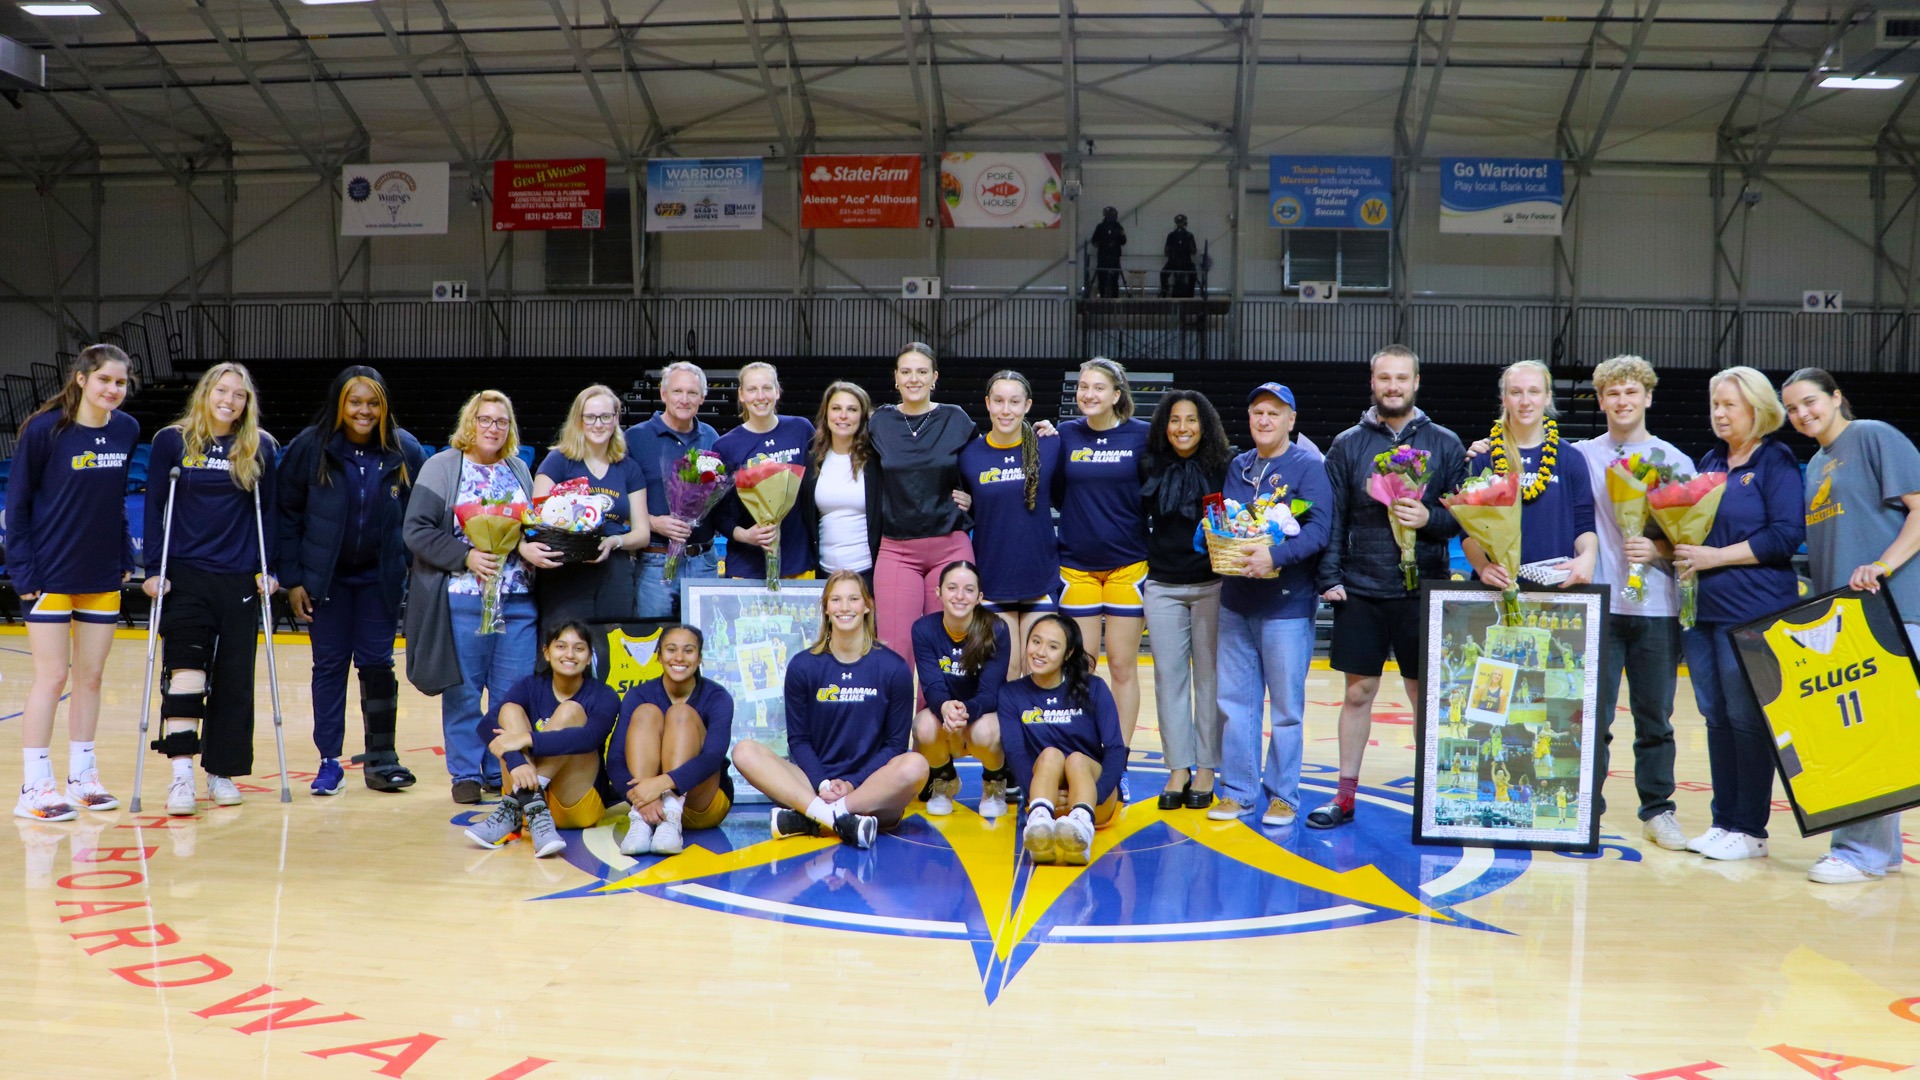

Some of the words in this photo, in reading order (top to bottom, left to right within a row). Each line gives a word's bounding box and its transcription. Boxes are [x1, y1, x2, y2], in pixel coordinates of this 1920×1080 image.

[536, 171, 546, 182] H
[546, 164, 586, 180] WILSON
[666, 168, 743, 179] WARRIORS
[1292, 165, 1319, 174] Thank
[1337, 166, 1348, 174] for
[1349, 166, 1371, 176] being
[1454, 162, 1474, 177] Go
[1479, 163, 1547, 178] Warriors!
[1280, 176, 1318, 184] Warriors
[1320, 177, 1337, 185] with
[1455, 181, 1473, 192] Play
[1501, 181, 1523, 191] Bank
[1525, 183, 1548, 192] local.
[1312, 187, 1359, 198] Supporting
[804, 195, 838, 204] Aleene
[841, 194, 870, 204] "Ace"
[872, 195, 917, 204] Althouse
[983, 199, 1017, 207] HOUSE
[1316, 197, 1347, 206] Student
[525, 212, 541, 221] (831)
[542, 212, 572, 220] 423-9522
[1315, 208, 1347, 216] Success.
[1516, 212, 1529, 223] Bay
[1530, 212, 1556, 220] Federal
[452, 285, 463, 298] H
[928, 281, 932, 294] I
[1323, 285, 1332, 299] J
[1824, 295, 1837, 308] K
[588, 487, 620, 498] ALIFORNIA
[1800, 657, 1878, 699] SLUGS
[840, 687, 878, 696] BANANA
[839, 694, 865, 702] SLUGS
[1043, 708, 1082, 717] BANANA
[1836, 689, 1863, 728] 11
